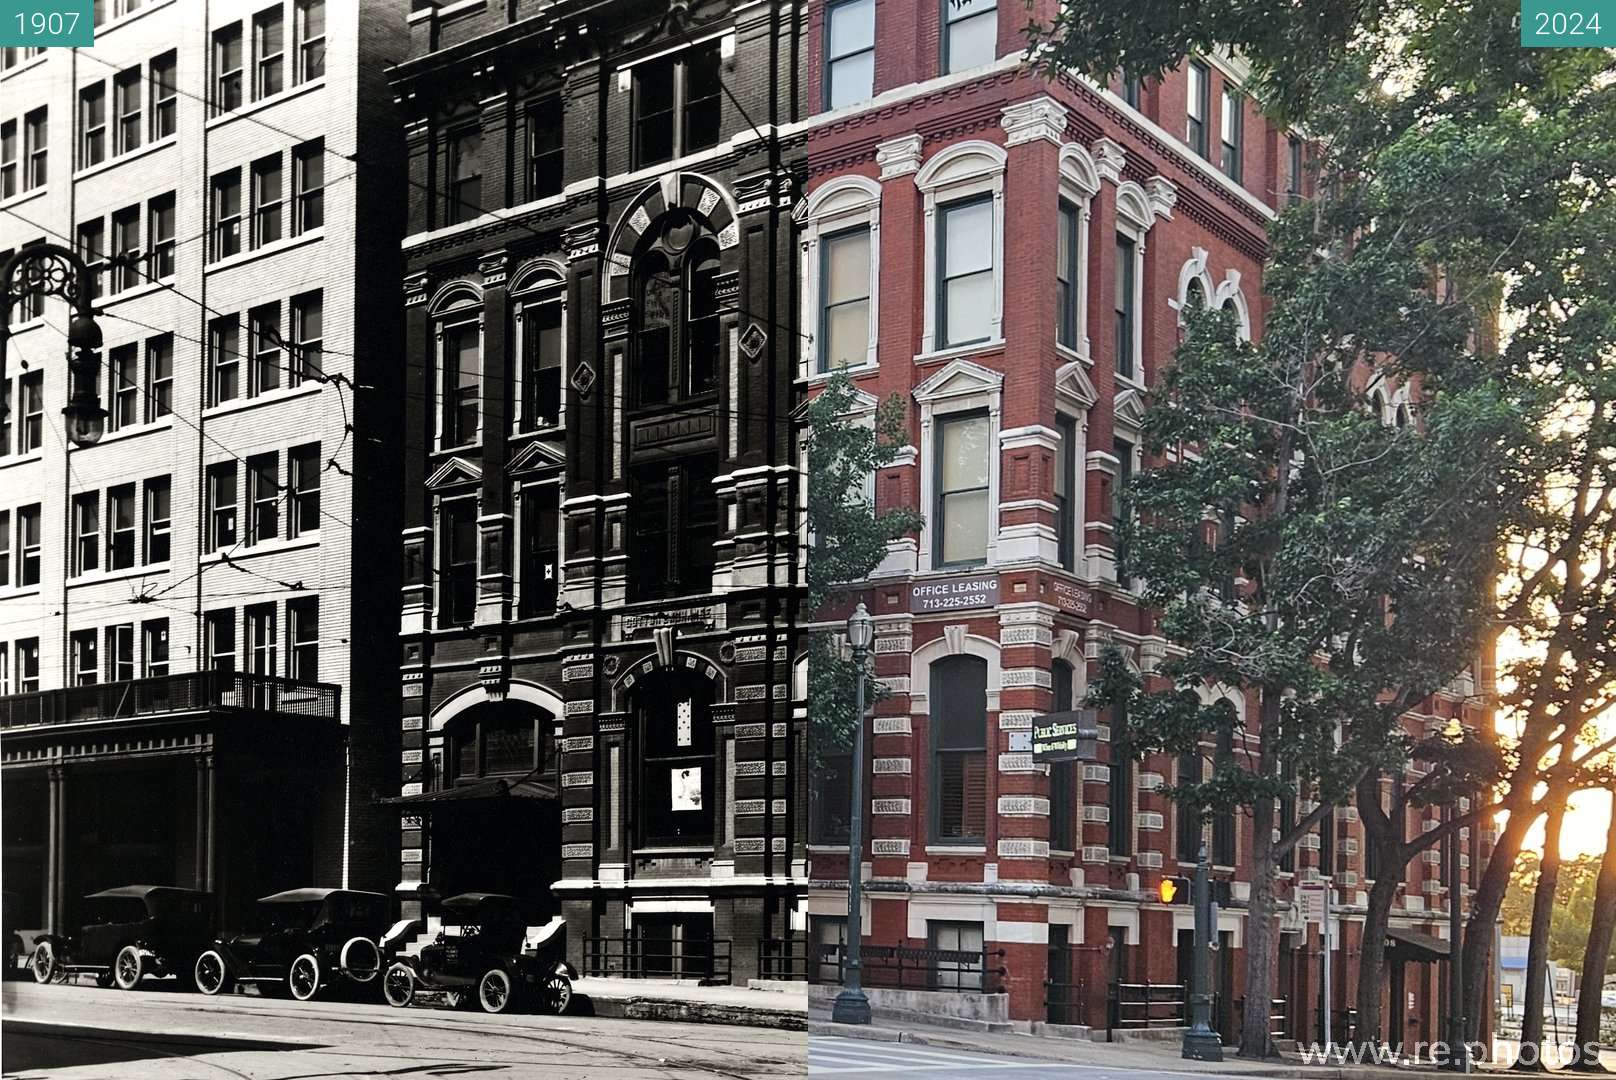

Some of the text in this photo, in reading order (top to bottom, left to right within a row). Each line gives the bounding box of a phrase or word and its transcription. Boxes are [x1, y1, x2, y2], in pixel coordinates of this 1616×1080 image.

[912, 580, 998, 597] OFFICE LEASING
[923, 594, 987, 609] 713-225-2552
